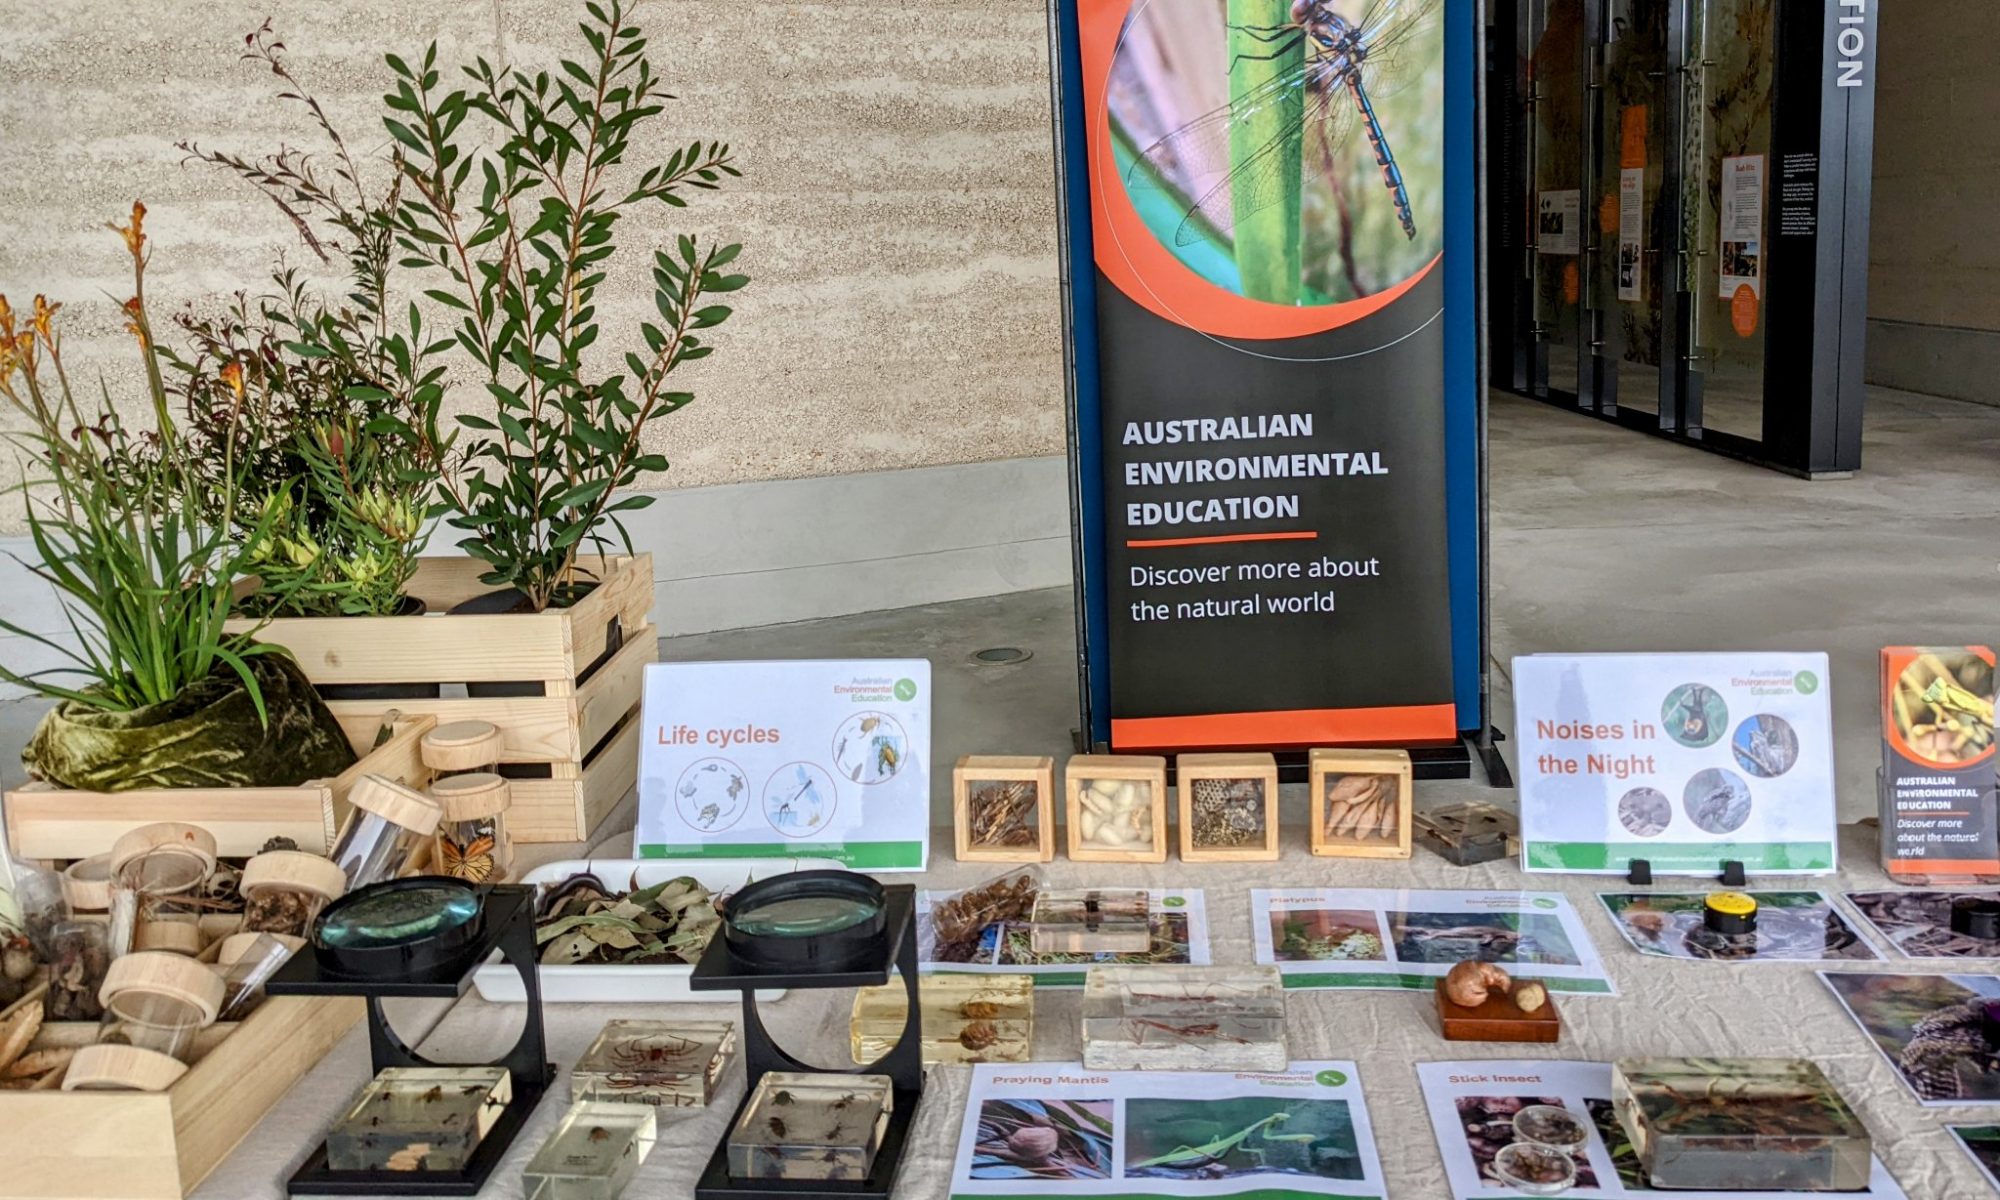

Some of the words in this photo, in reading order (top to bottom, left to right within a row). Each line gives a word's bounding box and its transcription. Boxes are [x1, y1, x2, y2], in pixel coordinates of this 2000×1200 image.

[1122, 413, 1313, 445] AUSTRALIAN
[1125, 452, 1389, 485] ENVIRONMENTAL
[1127, 495, 1299, 526] EDUCATION
[1130, 564, 1231, 587] Discover
[1238, 560, 1301, 581] more
[1308, 556, 1380, 578] about
[1131, 600, 1170, 621] the
[1177, 594, 1260, 619] natural
[1267, 591, 1335, 613] world
[833, 685, 892, 694] Environmental
[851, 694, 893, 702] Education
[1537, 720, 1624, 740] Noises
[1633, 720, 1655, 739] in
[658, 725, 699, 745] Life
[706, 724, 780, 749] cycles
[1539, 755, 1578, 774] the
[1587, 754, 1656, 779] Night
[1896, 777, 1956, 786] AUSTRALIAN
[1896, 788, 1978, 798] ENVIRONMENTAL
[1896, 801, 1952, 810] EDUCATION
[1896, 819, 1936, 828] Discover
[1937, 820, 1963, 828] more
[1897, 833, 1925, 842] about
[1926, 832, 1942, 842] the
[1943, 832, 1979, 842] natural
[1897, 846, 1925, 856] world
[992, 1075, 1053, 1085] Praying
[1057, 1076, 1110, 1084] Mantis
[1448, 1075, 1488, 1083] Stick
[1492, 1074, 1543, 1083] Insect
